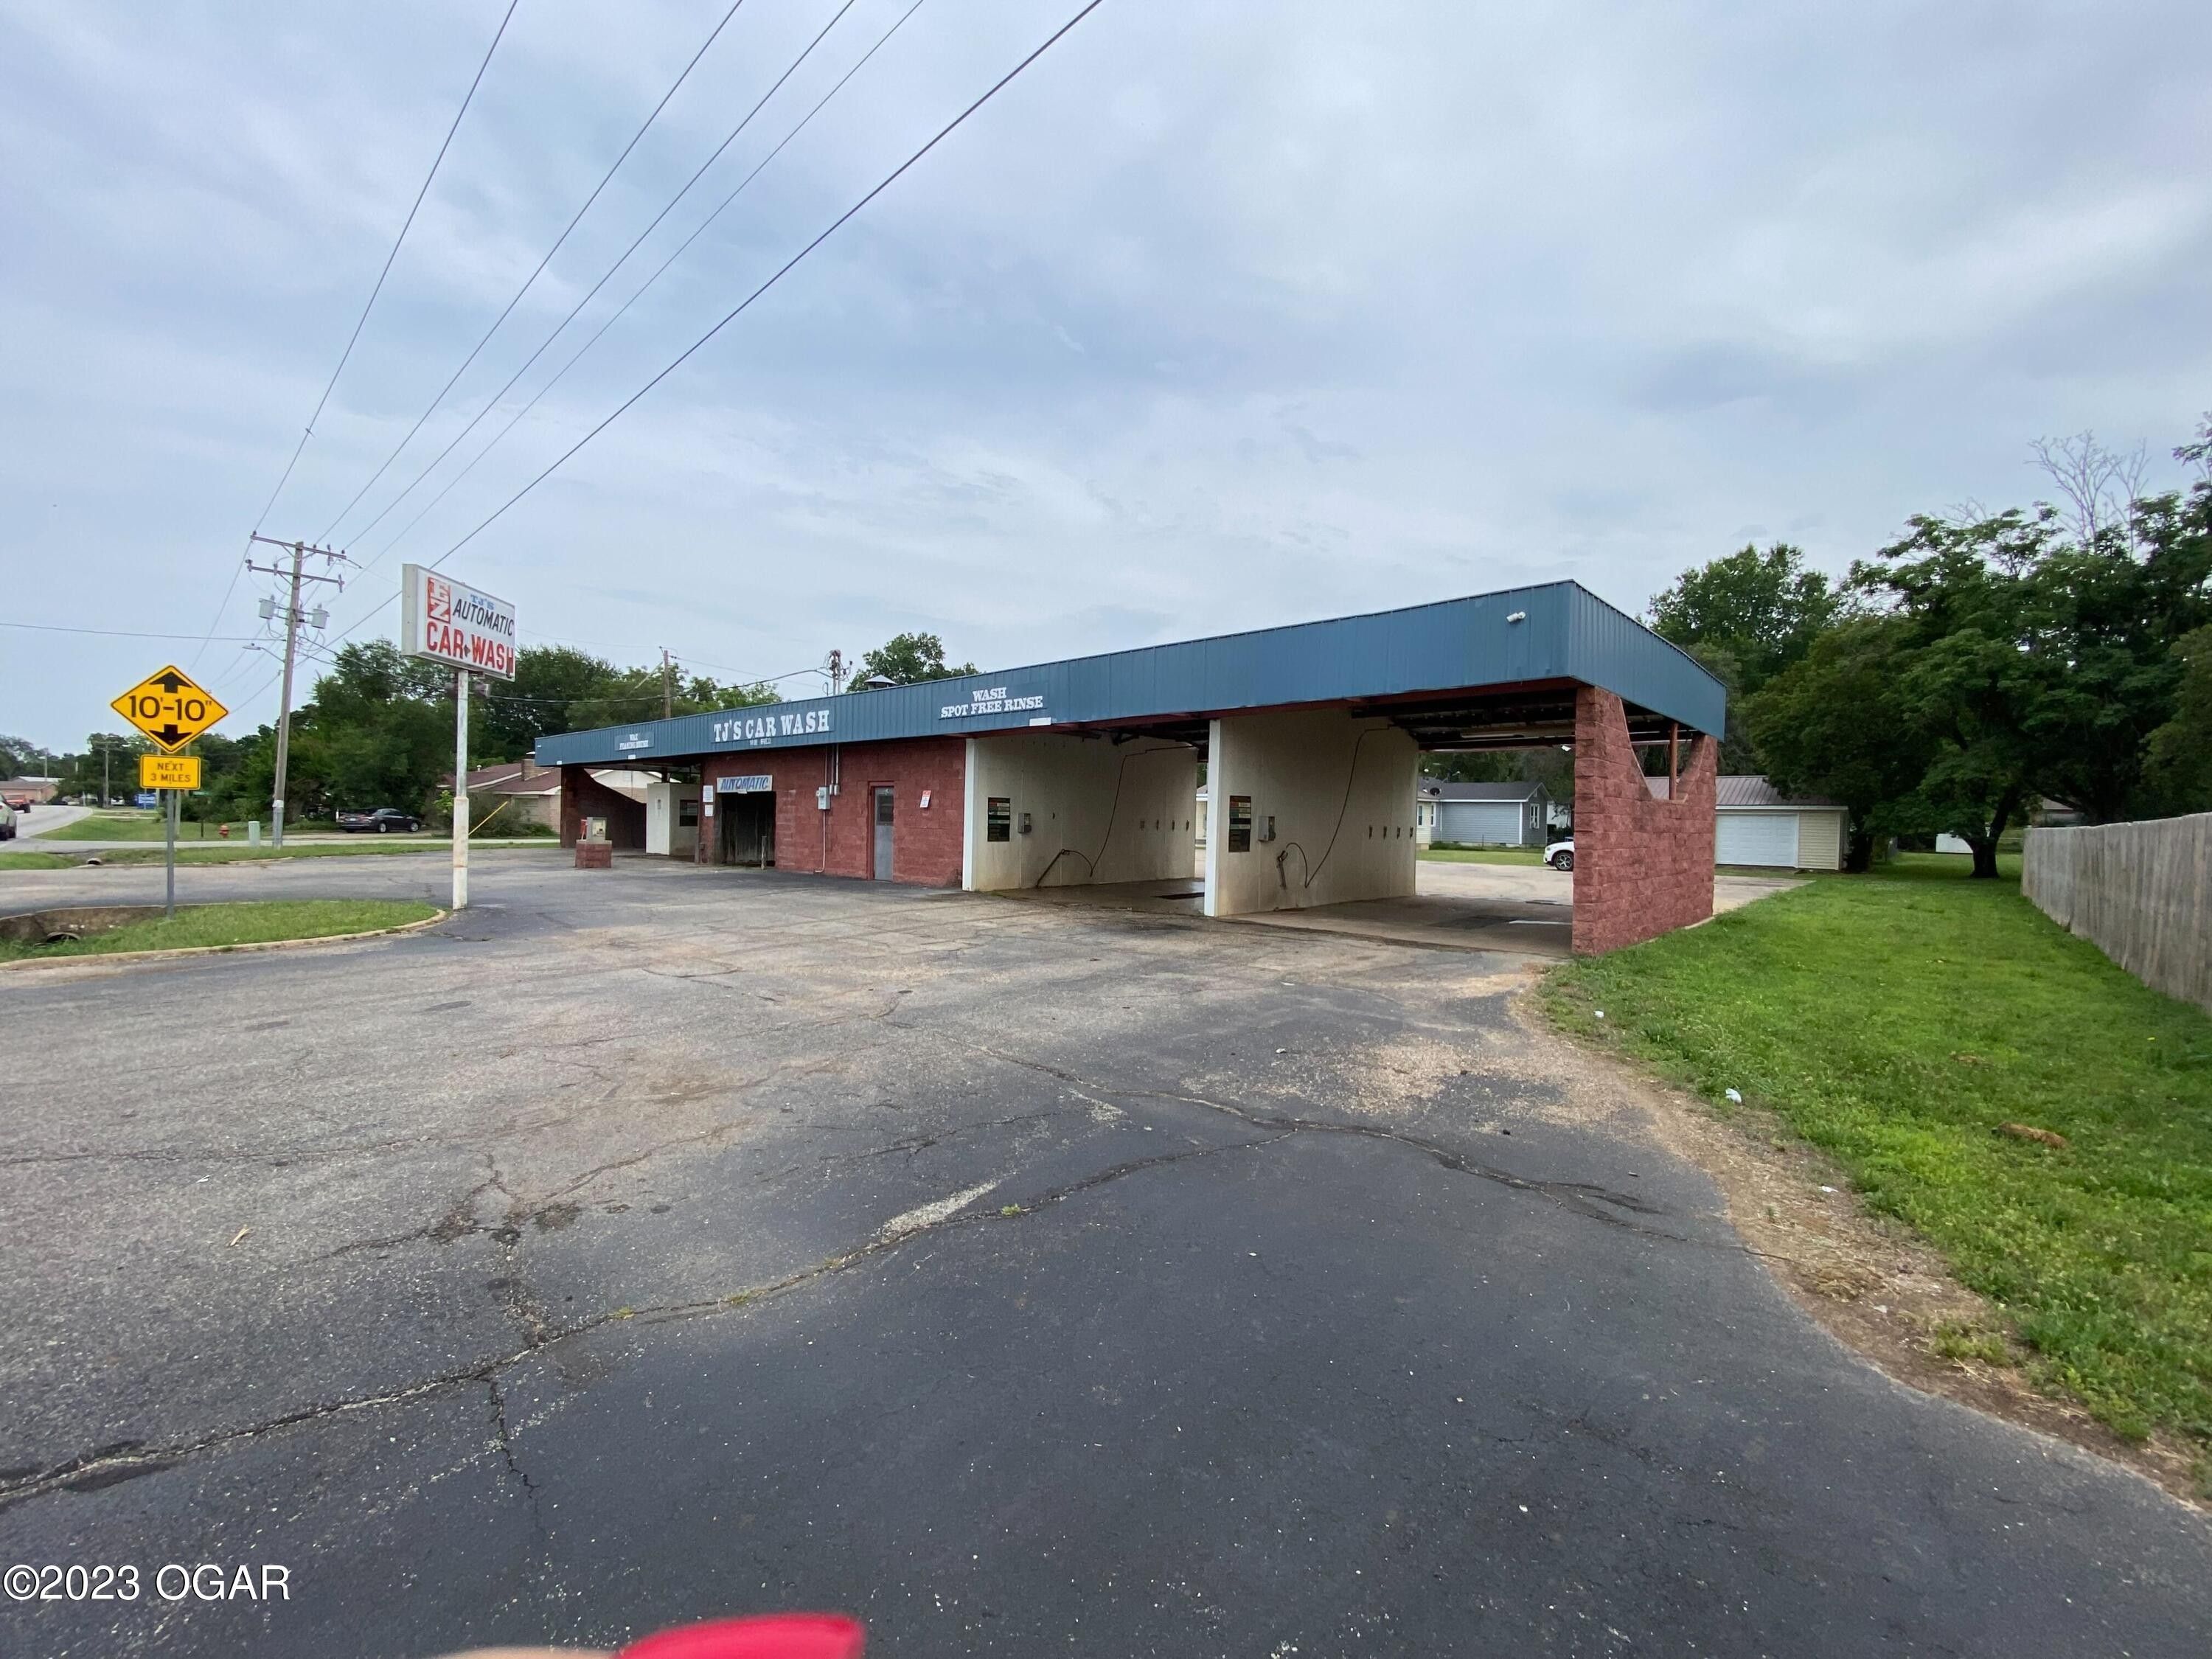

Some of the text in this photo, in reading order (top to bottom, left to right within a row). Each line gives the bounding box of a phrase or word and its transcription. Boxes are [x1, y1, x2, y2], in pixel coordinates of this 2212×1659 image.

[453, 599, 514, 636] AUTOMATIC
[426, 622, 514, 673] CAR WASH
[973, 687, 1006, 701] WASH
[941, 695, 1043, 718] SPOT FREE RINSE
[714, 710, 830, 742] TJ'S CAR WASH
[157, 762, 184, 771] NEXT
[150, 773, 191, 782] 3 MILES
[720, 777, 770, 791] AUTOMATIC
